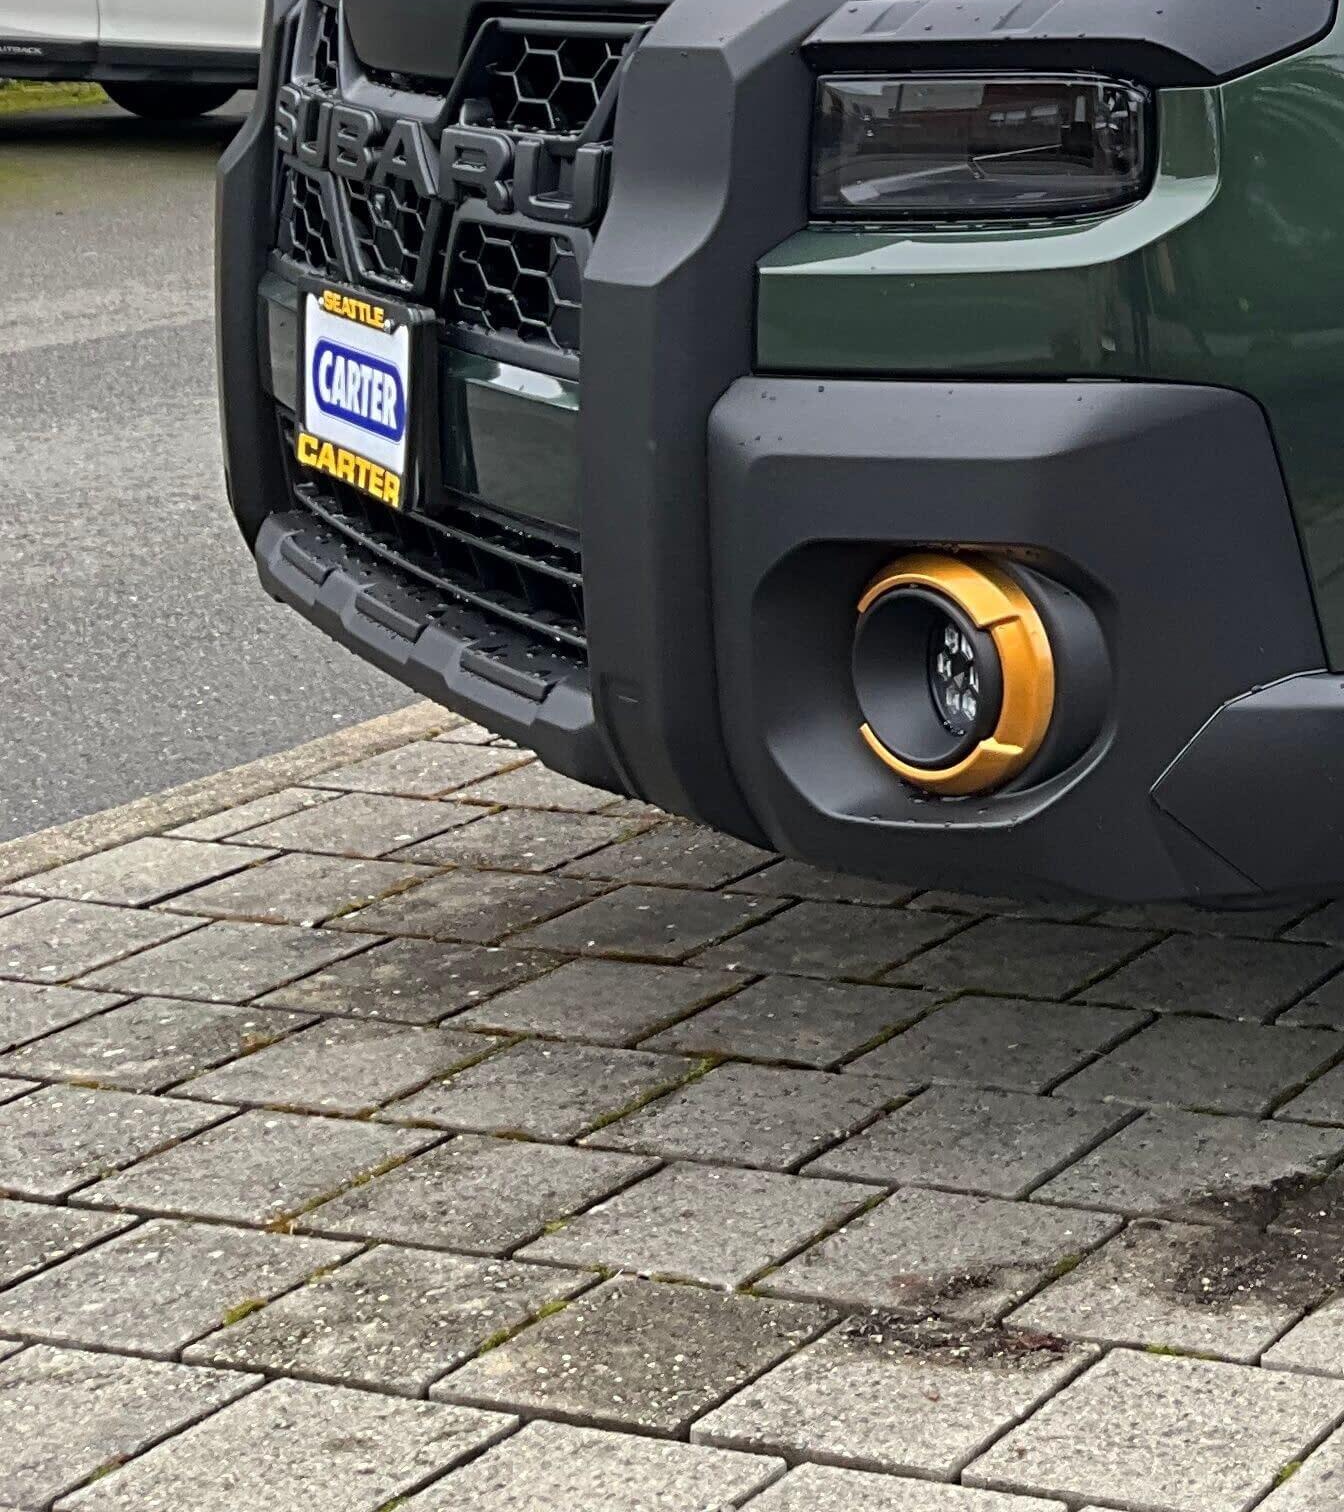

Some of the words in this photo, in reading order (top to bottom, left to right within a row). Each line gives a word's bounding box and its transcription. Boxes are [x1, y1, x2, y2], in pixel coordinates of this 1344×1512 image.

[0, 45, 42, 56] UTBACK
[275, 85, 614, 229] SUBARU
[323, 290, 385, 330] SEATTLE
[317, 349, 398, 430] CARTER
[297, 432, 400, 508] CARTER
